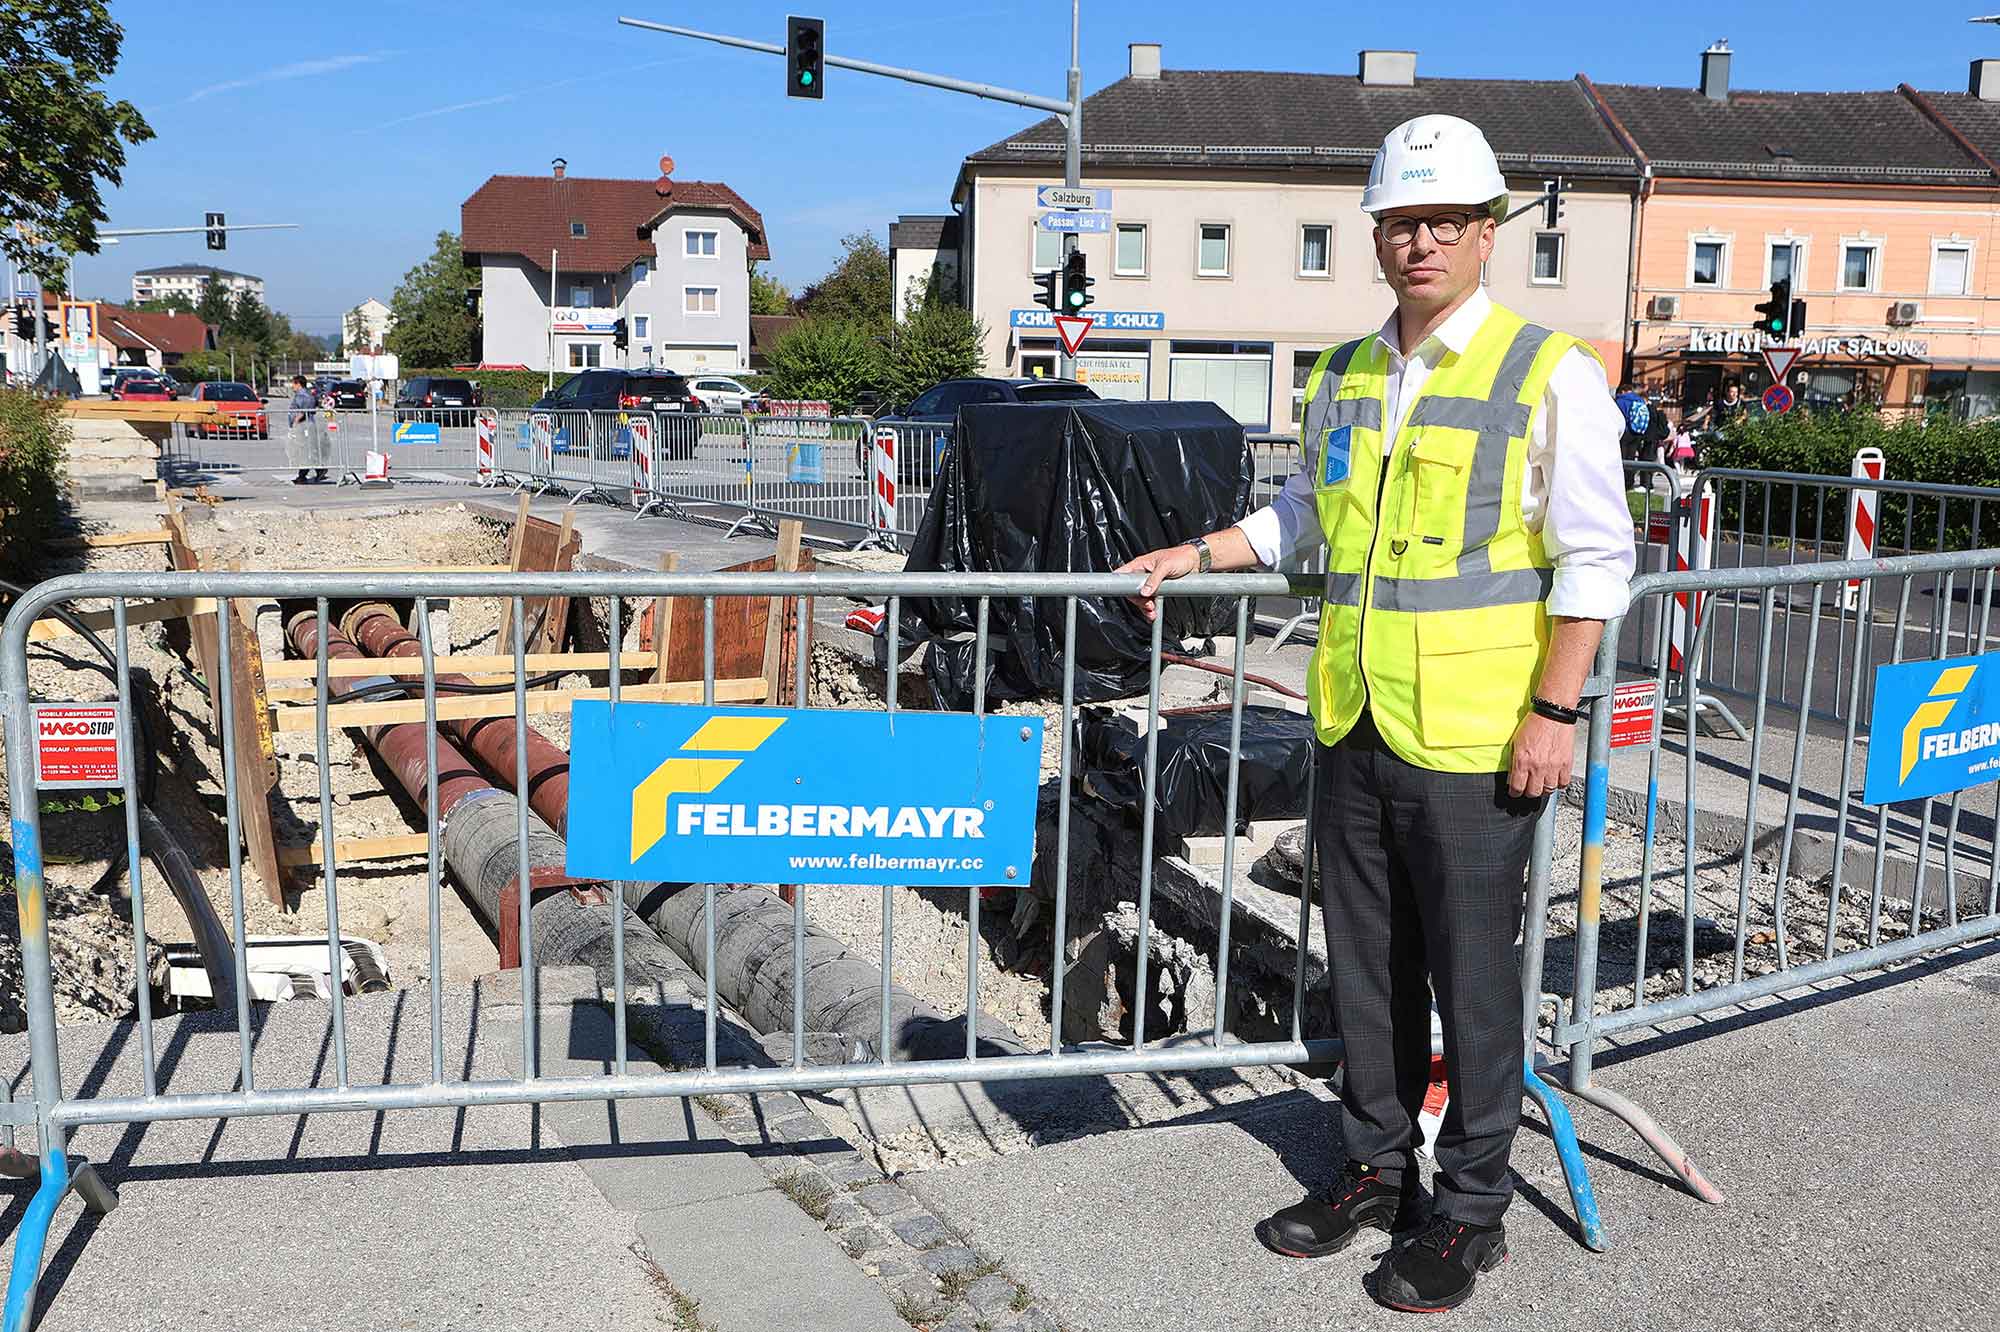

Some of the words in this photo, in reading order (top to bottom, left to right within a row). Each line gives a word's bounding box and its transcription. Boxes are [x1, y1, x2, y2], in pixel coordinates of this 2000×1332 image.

[1052, 191, 1091, 206] Salzburg
[1048, 215, 1073, 227] Passau
[1079, 216, 1095, 227] Linz
[1112, 313, 1159, 327] SCHULZ
[1798, 338, 1841, 354] HAIR
[1847, 339, 1913, 355] SALON
[676, 802, 985, 838] FELBERMAYR
[788, 853, 984, 873] www.felbermayr.cc
